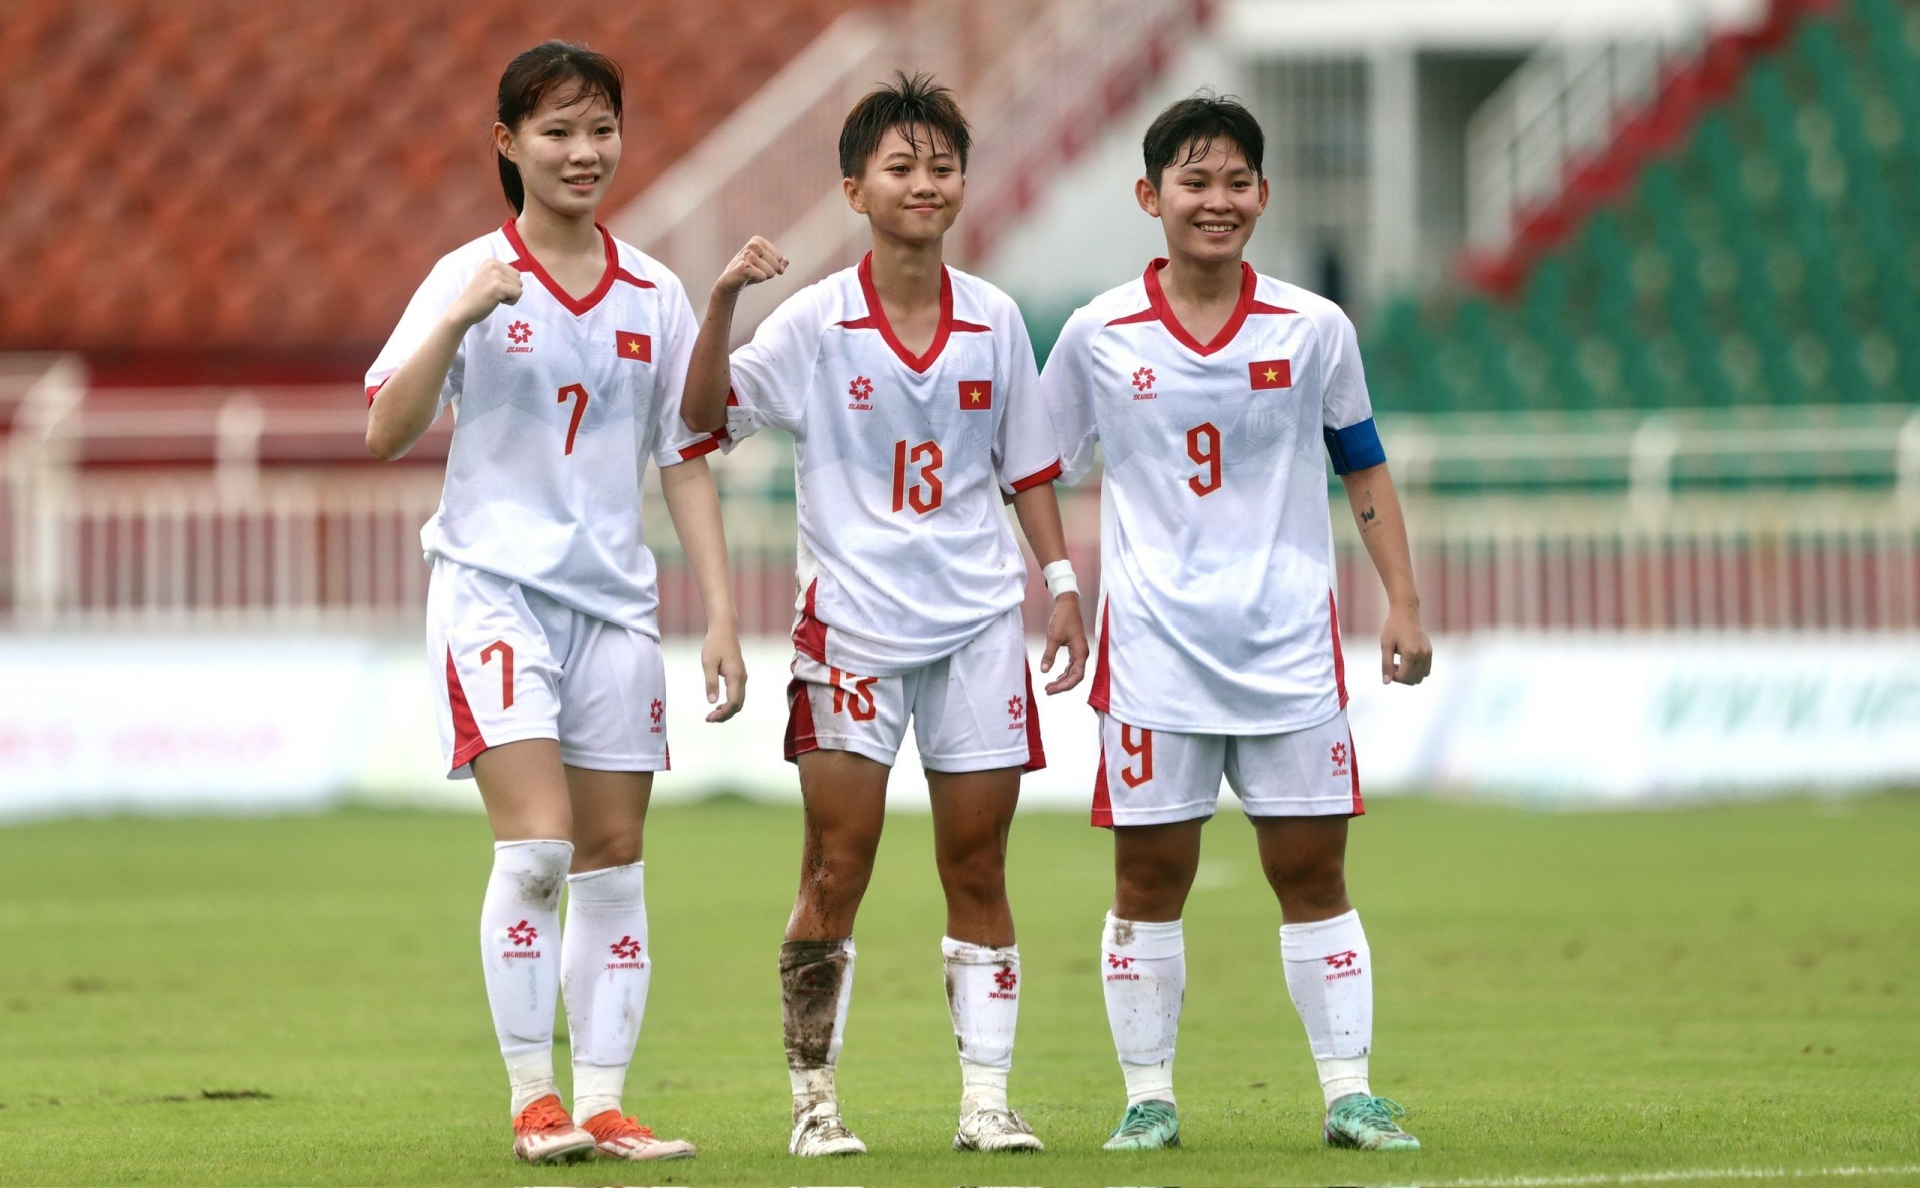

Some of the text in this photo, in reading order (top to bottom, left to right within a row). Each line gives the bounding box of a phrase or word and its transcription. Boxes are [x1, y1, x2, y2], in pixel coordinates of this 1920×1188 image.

[557, 383, 589, 456] 7
[892, 439, 943, 515] 13
[1186, 421, 1222, 498] 9
[480, 639, 514, 711] 7
[1121, 722, 1153, 789] 9
